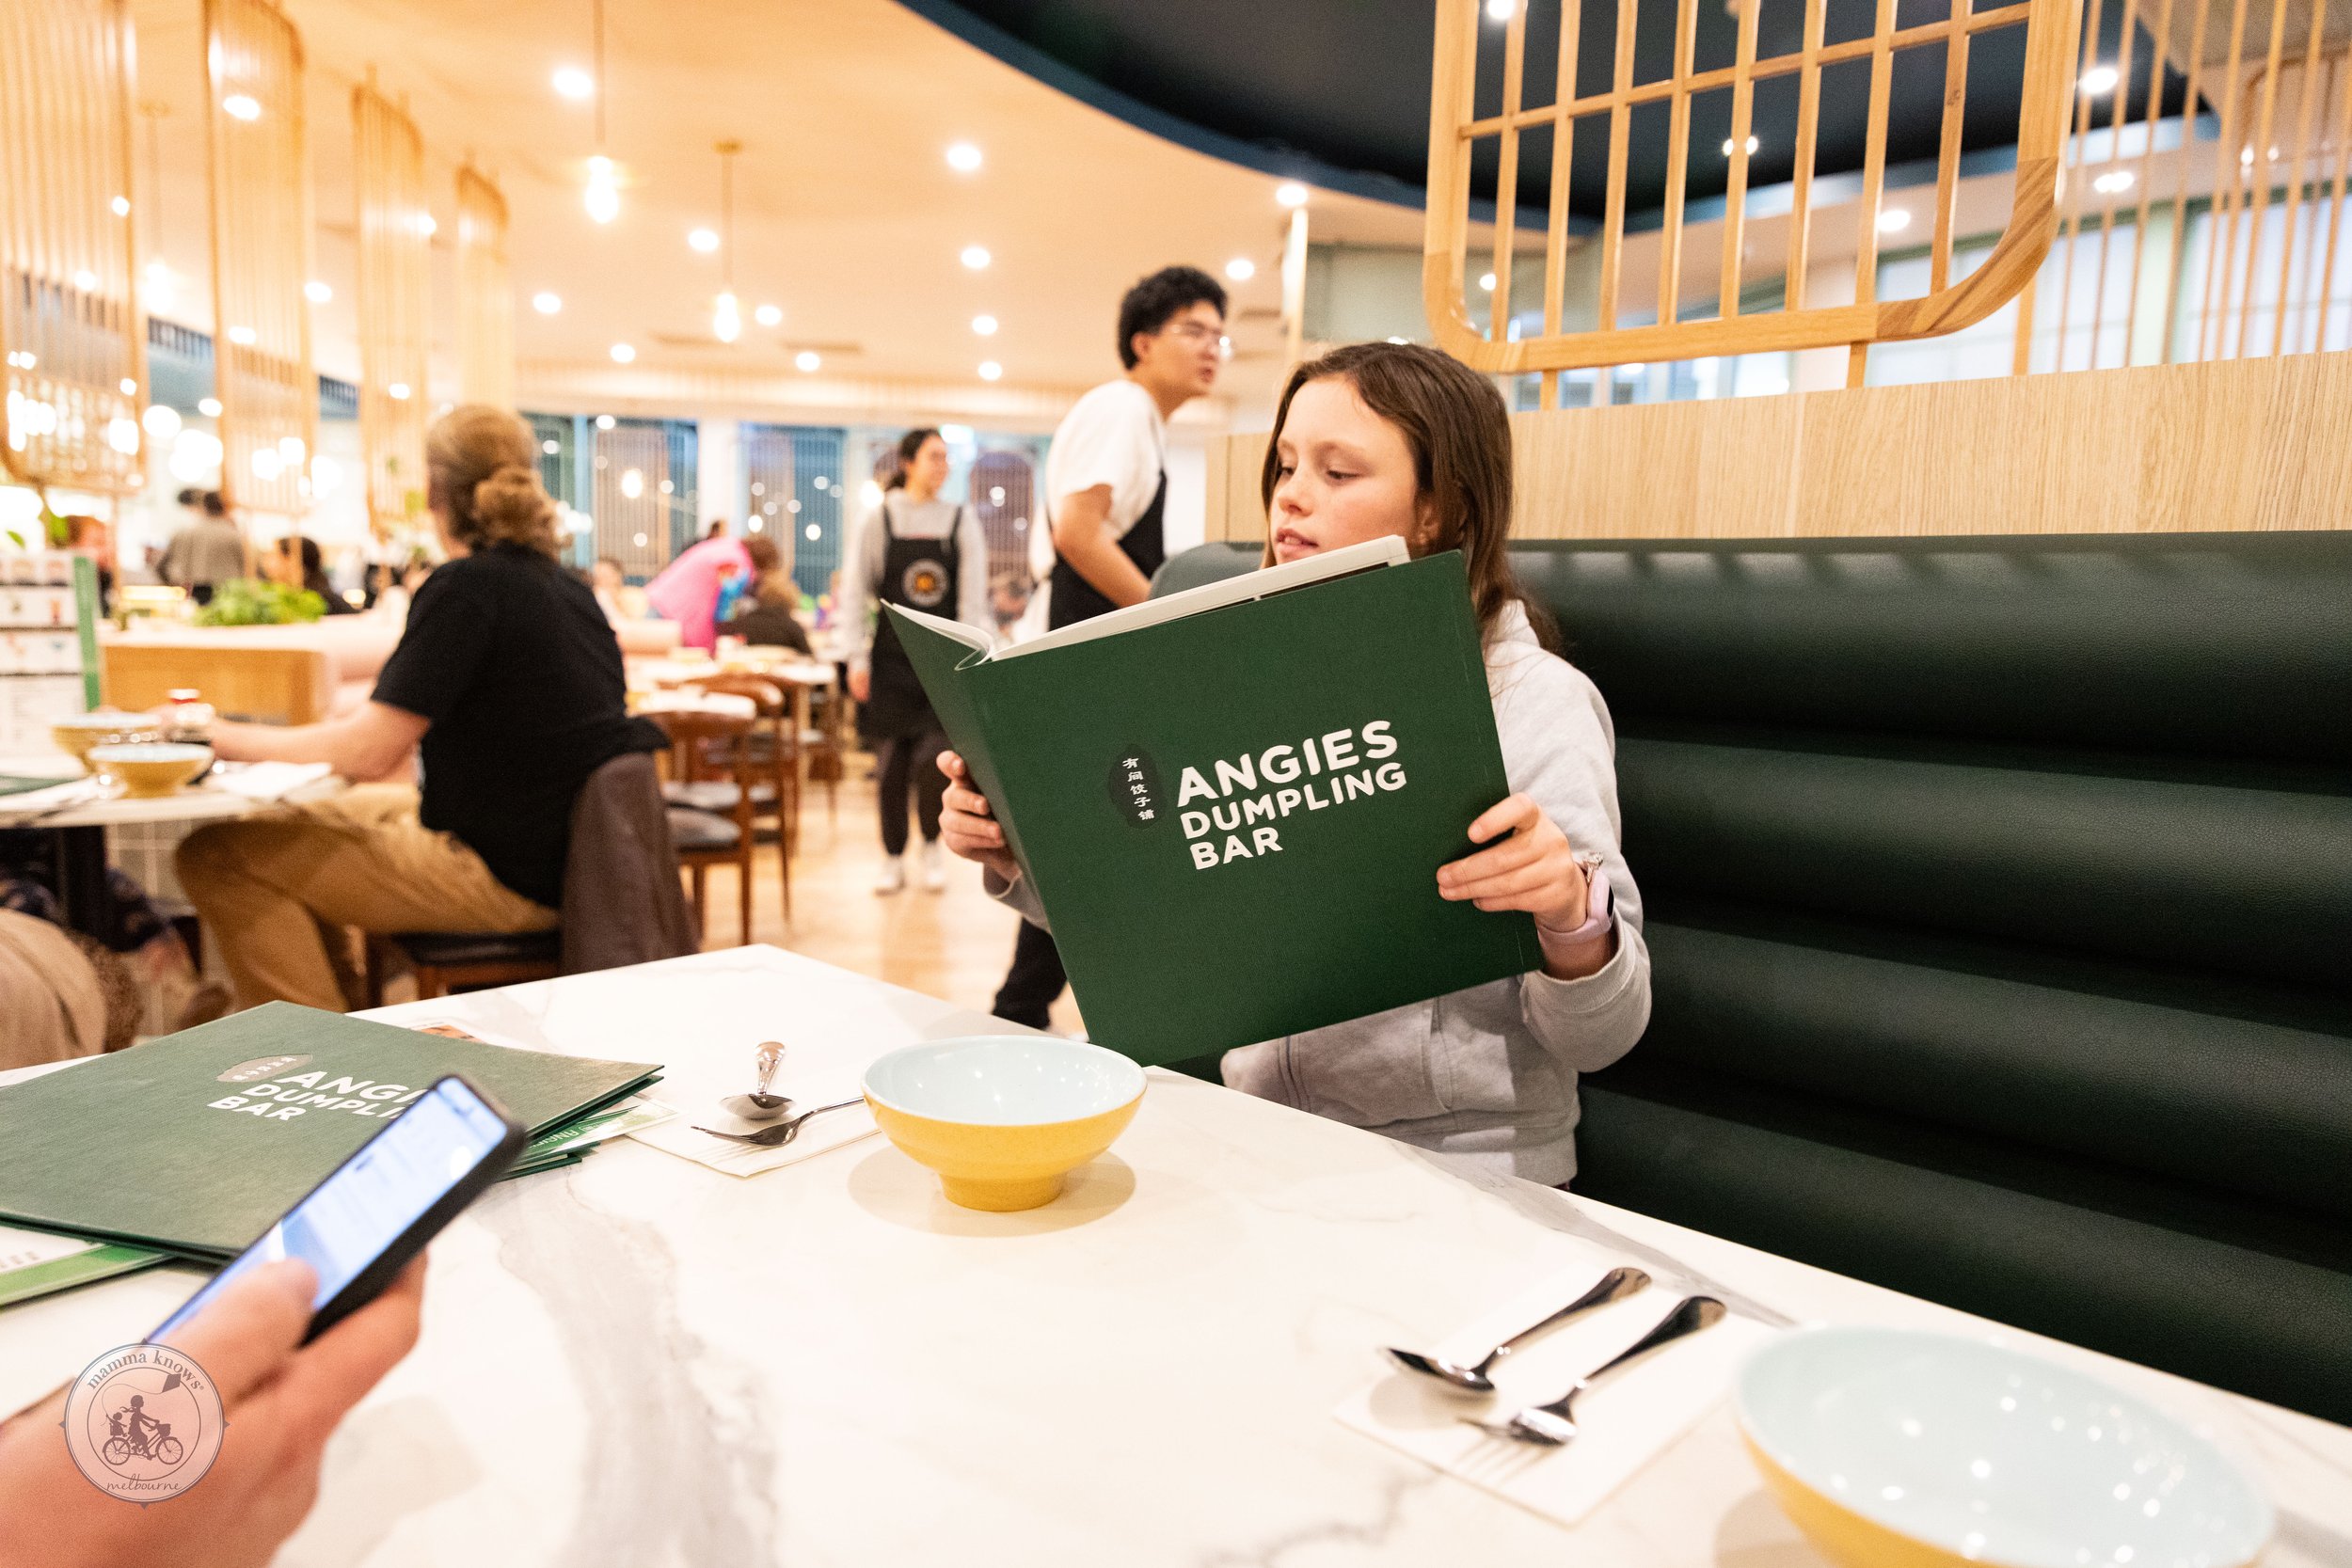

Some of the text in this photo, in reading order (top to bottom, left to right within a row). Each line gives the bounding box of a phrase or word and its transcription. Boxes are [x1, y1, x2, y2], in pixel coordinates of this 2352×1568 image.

[1178, 721, 1398, 808] ANGIES
[1180, 762, 1407, 840] DUMPLING
[1189, 827, 1284, 870] BAR
[241, 1084, 405, 1119] DUMPLI
[273, 1070, 429, 1104] ANGI
[206, 1096, 308, 1121] BAR
